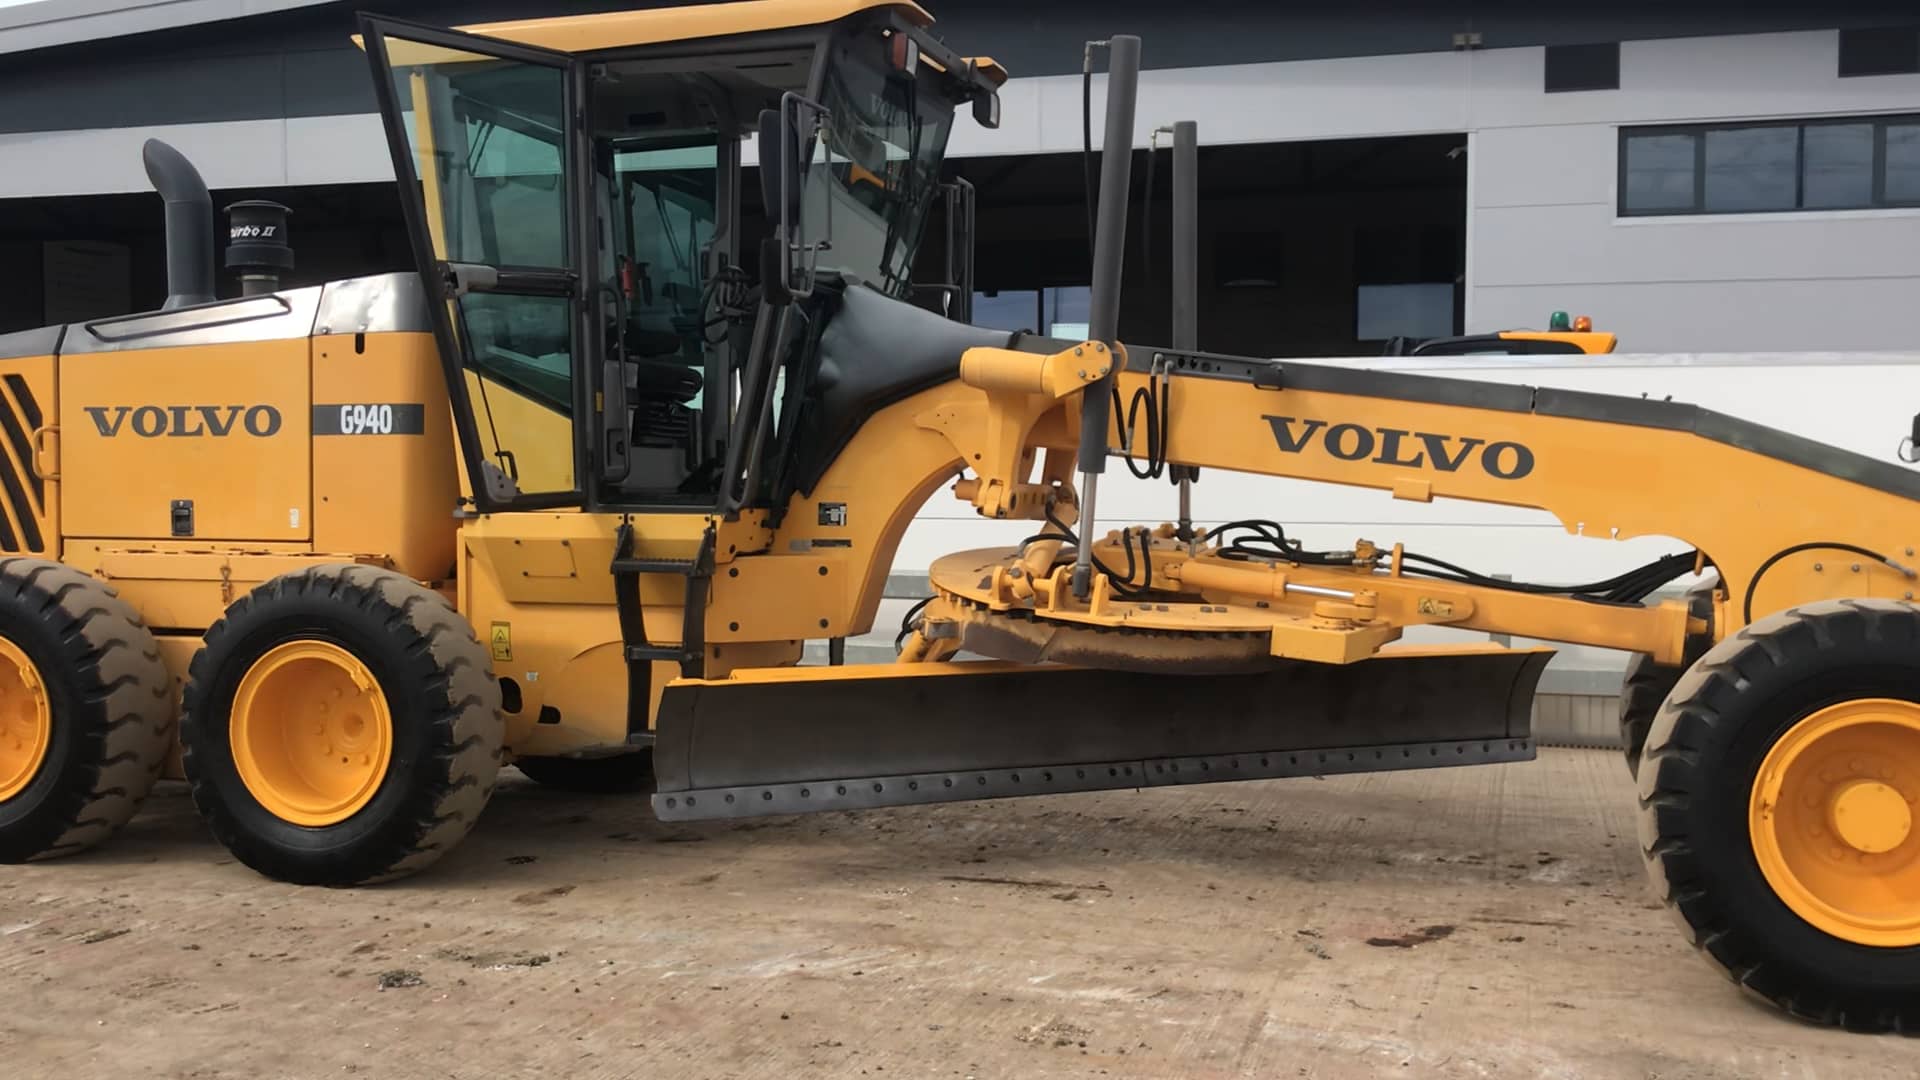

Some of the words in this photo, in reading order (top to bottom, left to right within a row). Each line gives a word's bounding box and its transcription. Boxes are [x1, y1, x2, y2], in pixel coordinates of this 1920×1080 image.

[83, 404, 282, 438] VOLVO
[340, 404, 393, 434] G940
[1260, 414, 1535, 480] VOLVO
